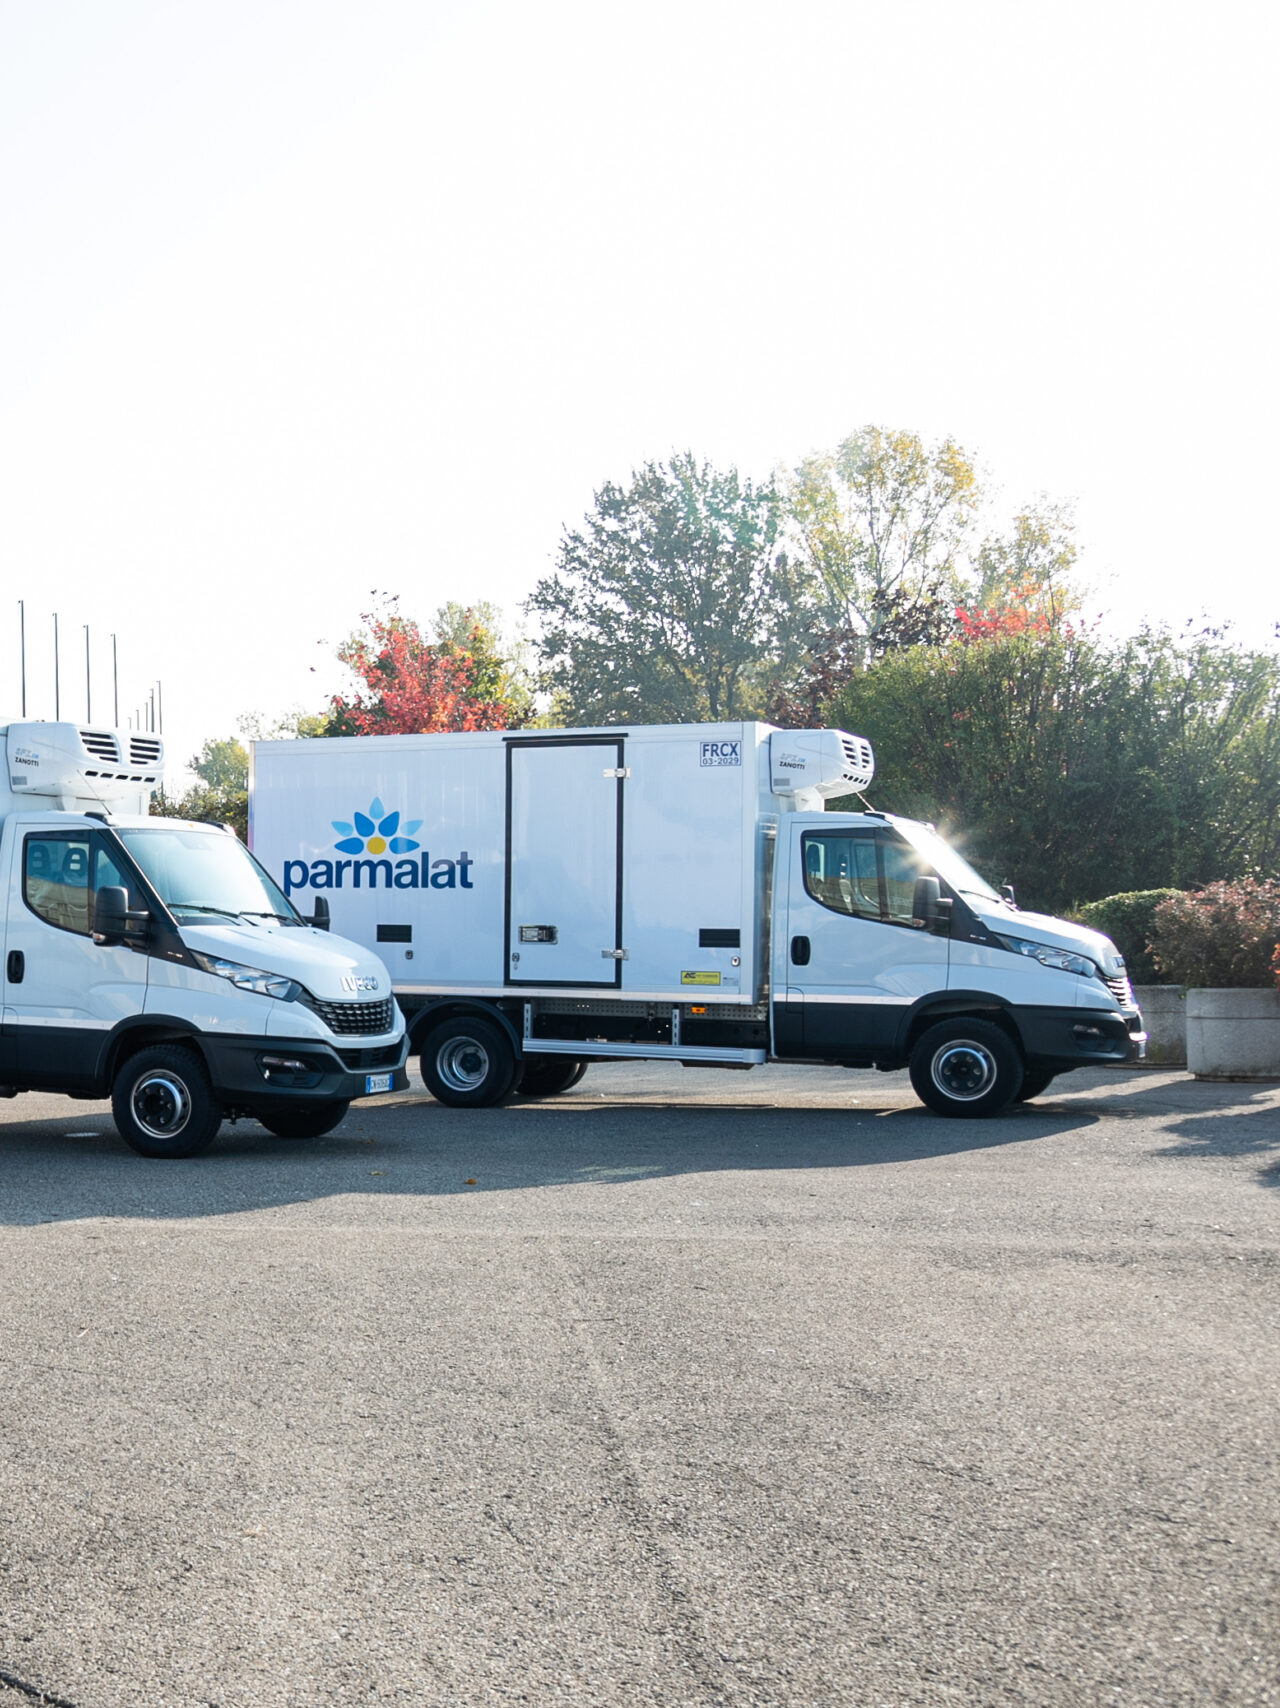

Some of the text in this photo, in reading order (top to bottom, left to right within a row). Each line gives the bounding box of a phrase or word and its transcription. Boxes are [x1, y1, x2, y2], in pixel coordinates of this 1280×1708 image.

[703, 743, 738, 757] FRCX
[15, 757, 39, 767] ZANOTTI
[703, 757, 739, 765] 03-2029
[779, 761, 805, 770] ZANOTTI
[283, 851, 474, 897] parmalat
[340, 976, 379, 991] IVECO
